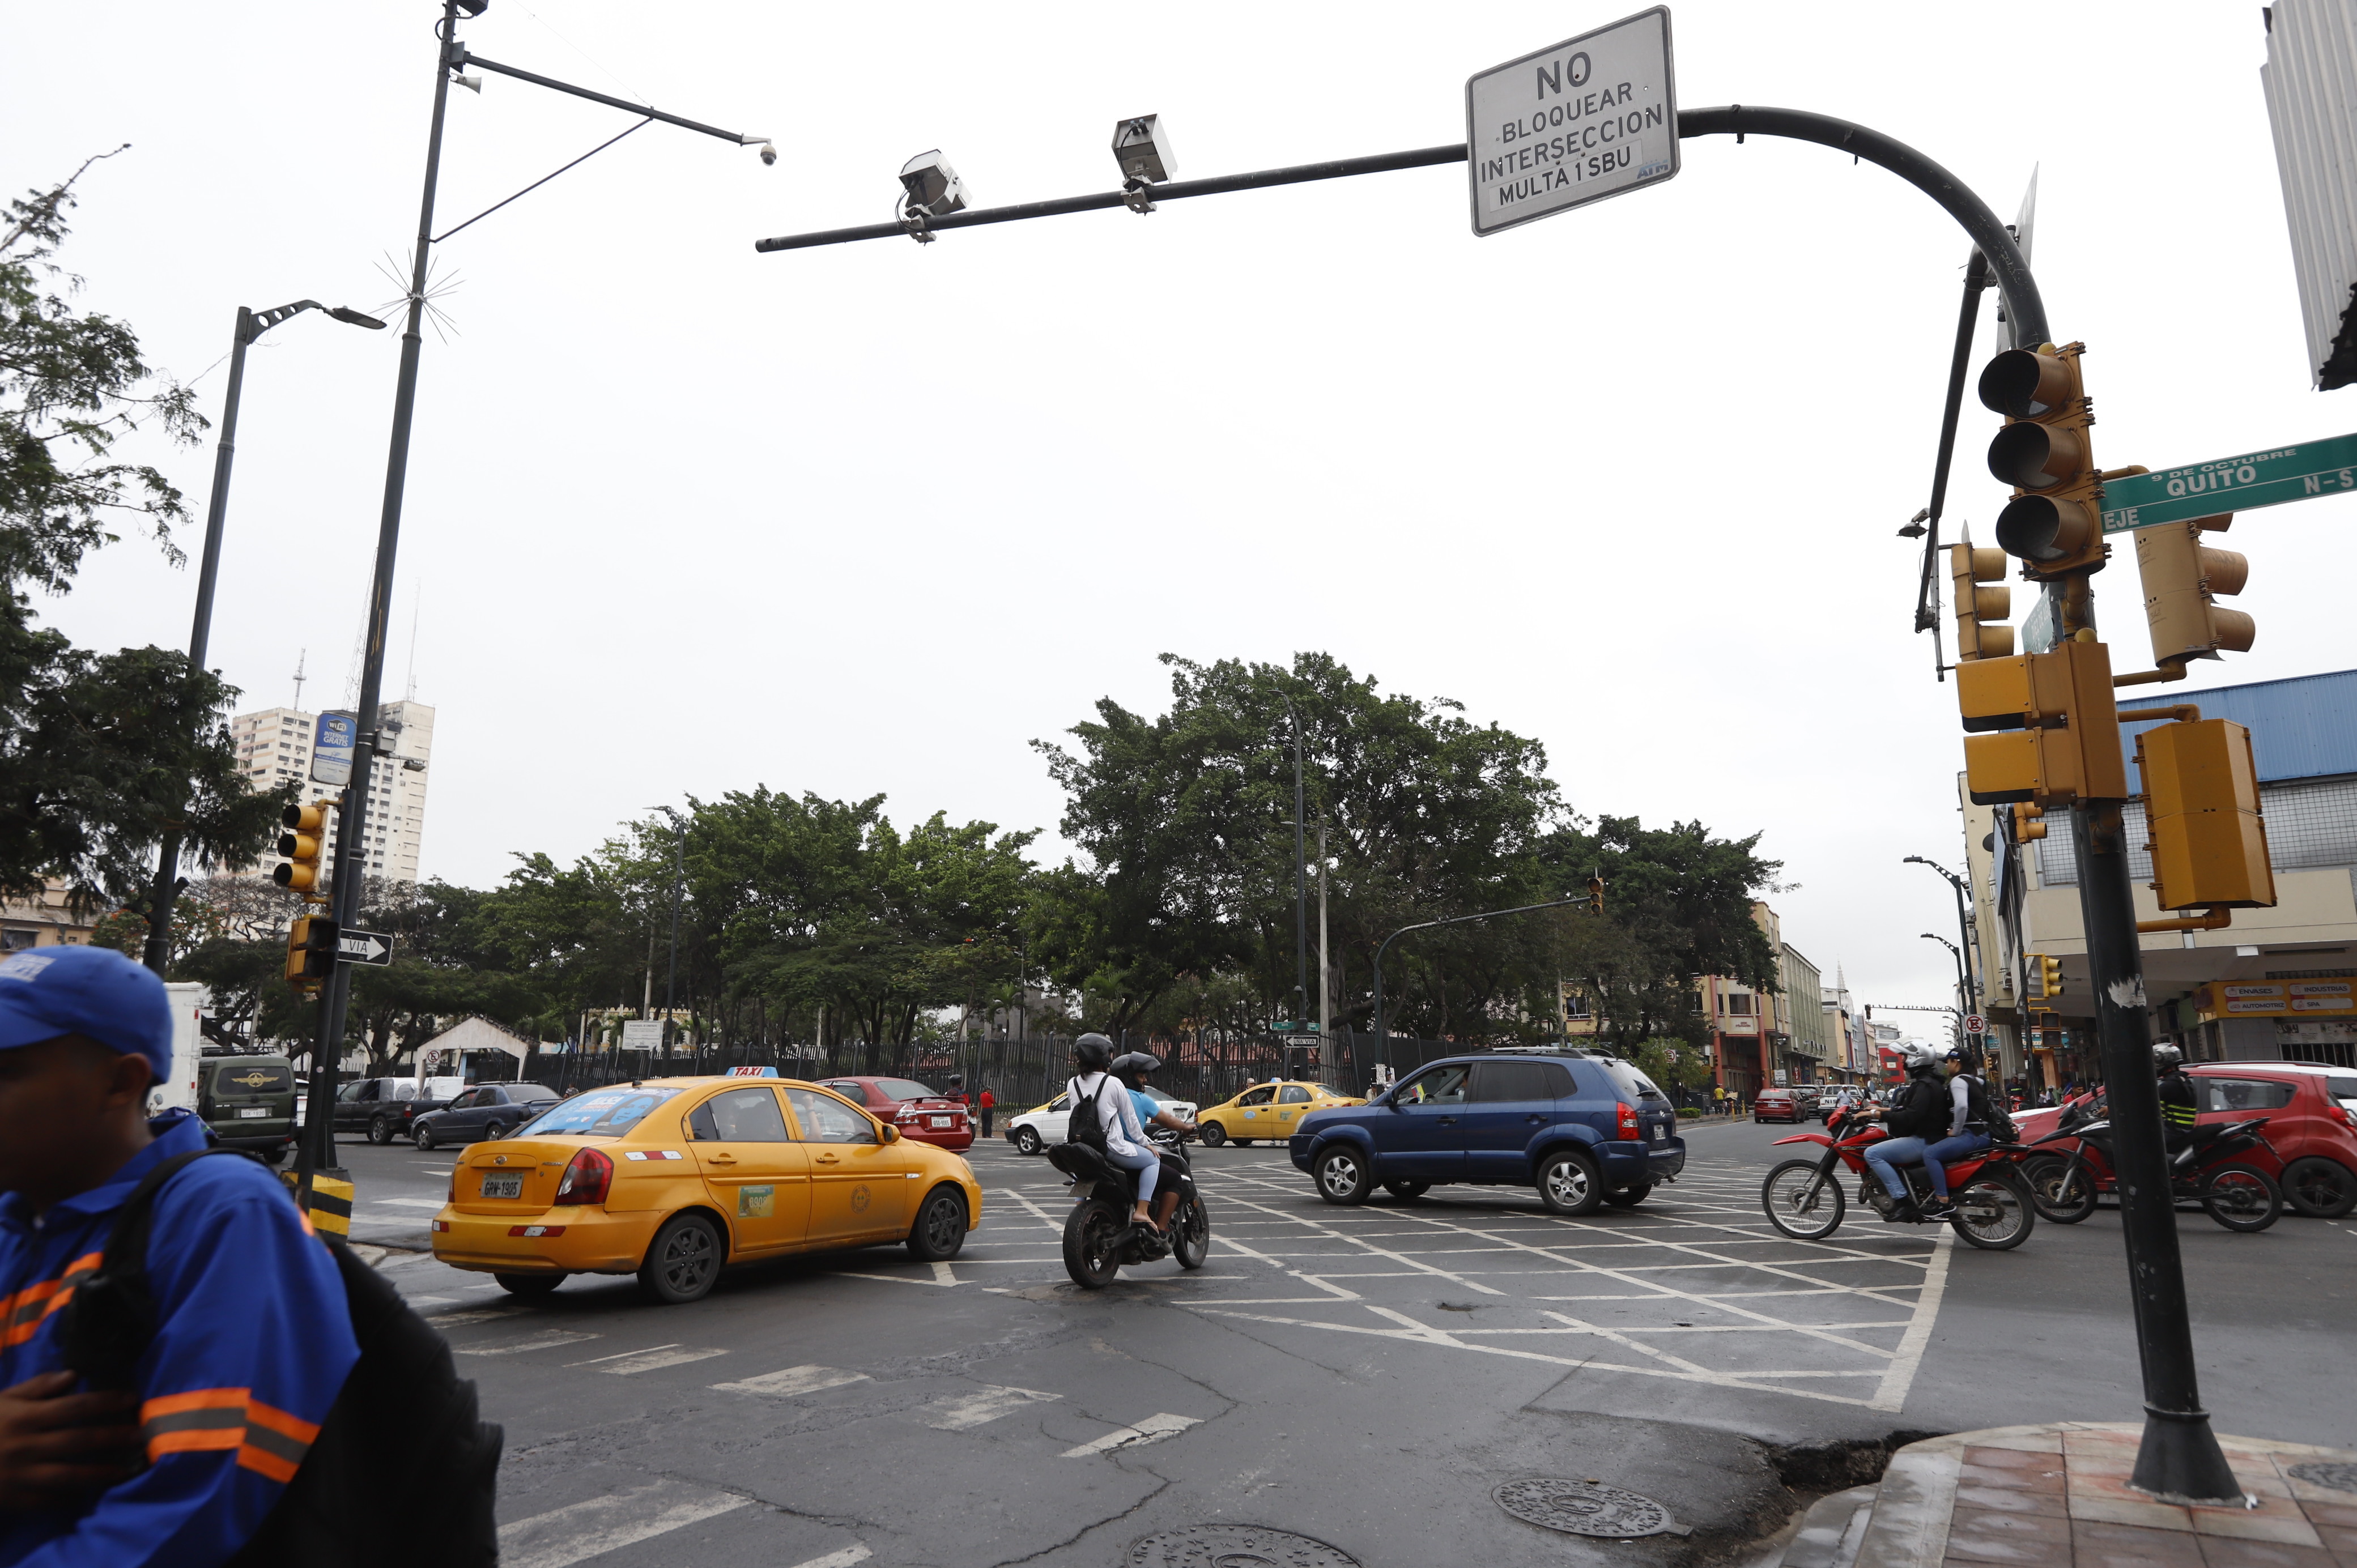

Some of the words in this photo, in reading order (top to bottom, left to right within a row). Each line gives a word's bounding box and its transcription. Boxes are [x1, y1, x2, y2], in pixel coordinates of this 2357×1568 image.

[1537, 52, 1592, 100] NO
[1503, 82, 1633, 144] BLOQUEAR
[1481, 104, 1662, 183] INTERSECCION
[1499, 168, 1569, 206] MULTA
[1575, 162, 1582, 181] 1
[1588, 146, 1631, 177] SBU
[2169, 467, 2194, 479] DE
[2201, 449, 2296, 472] OCTUBRE
[2167, 465, 2256, 497] QUITO
[2104, 508, 2140, 530] EJE
[323, 736, 348, 747] GRATIS
[324, 731, 349, 740] INTERNET
[350, 940, 367, 953] VIA
[735, 1067, 763, 1076] TAXI
